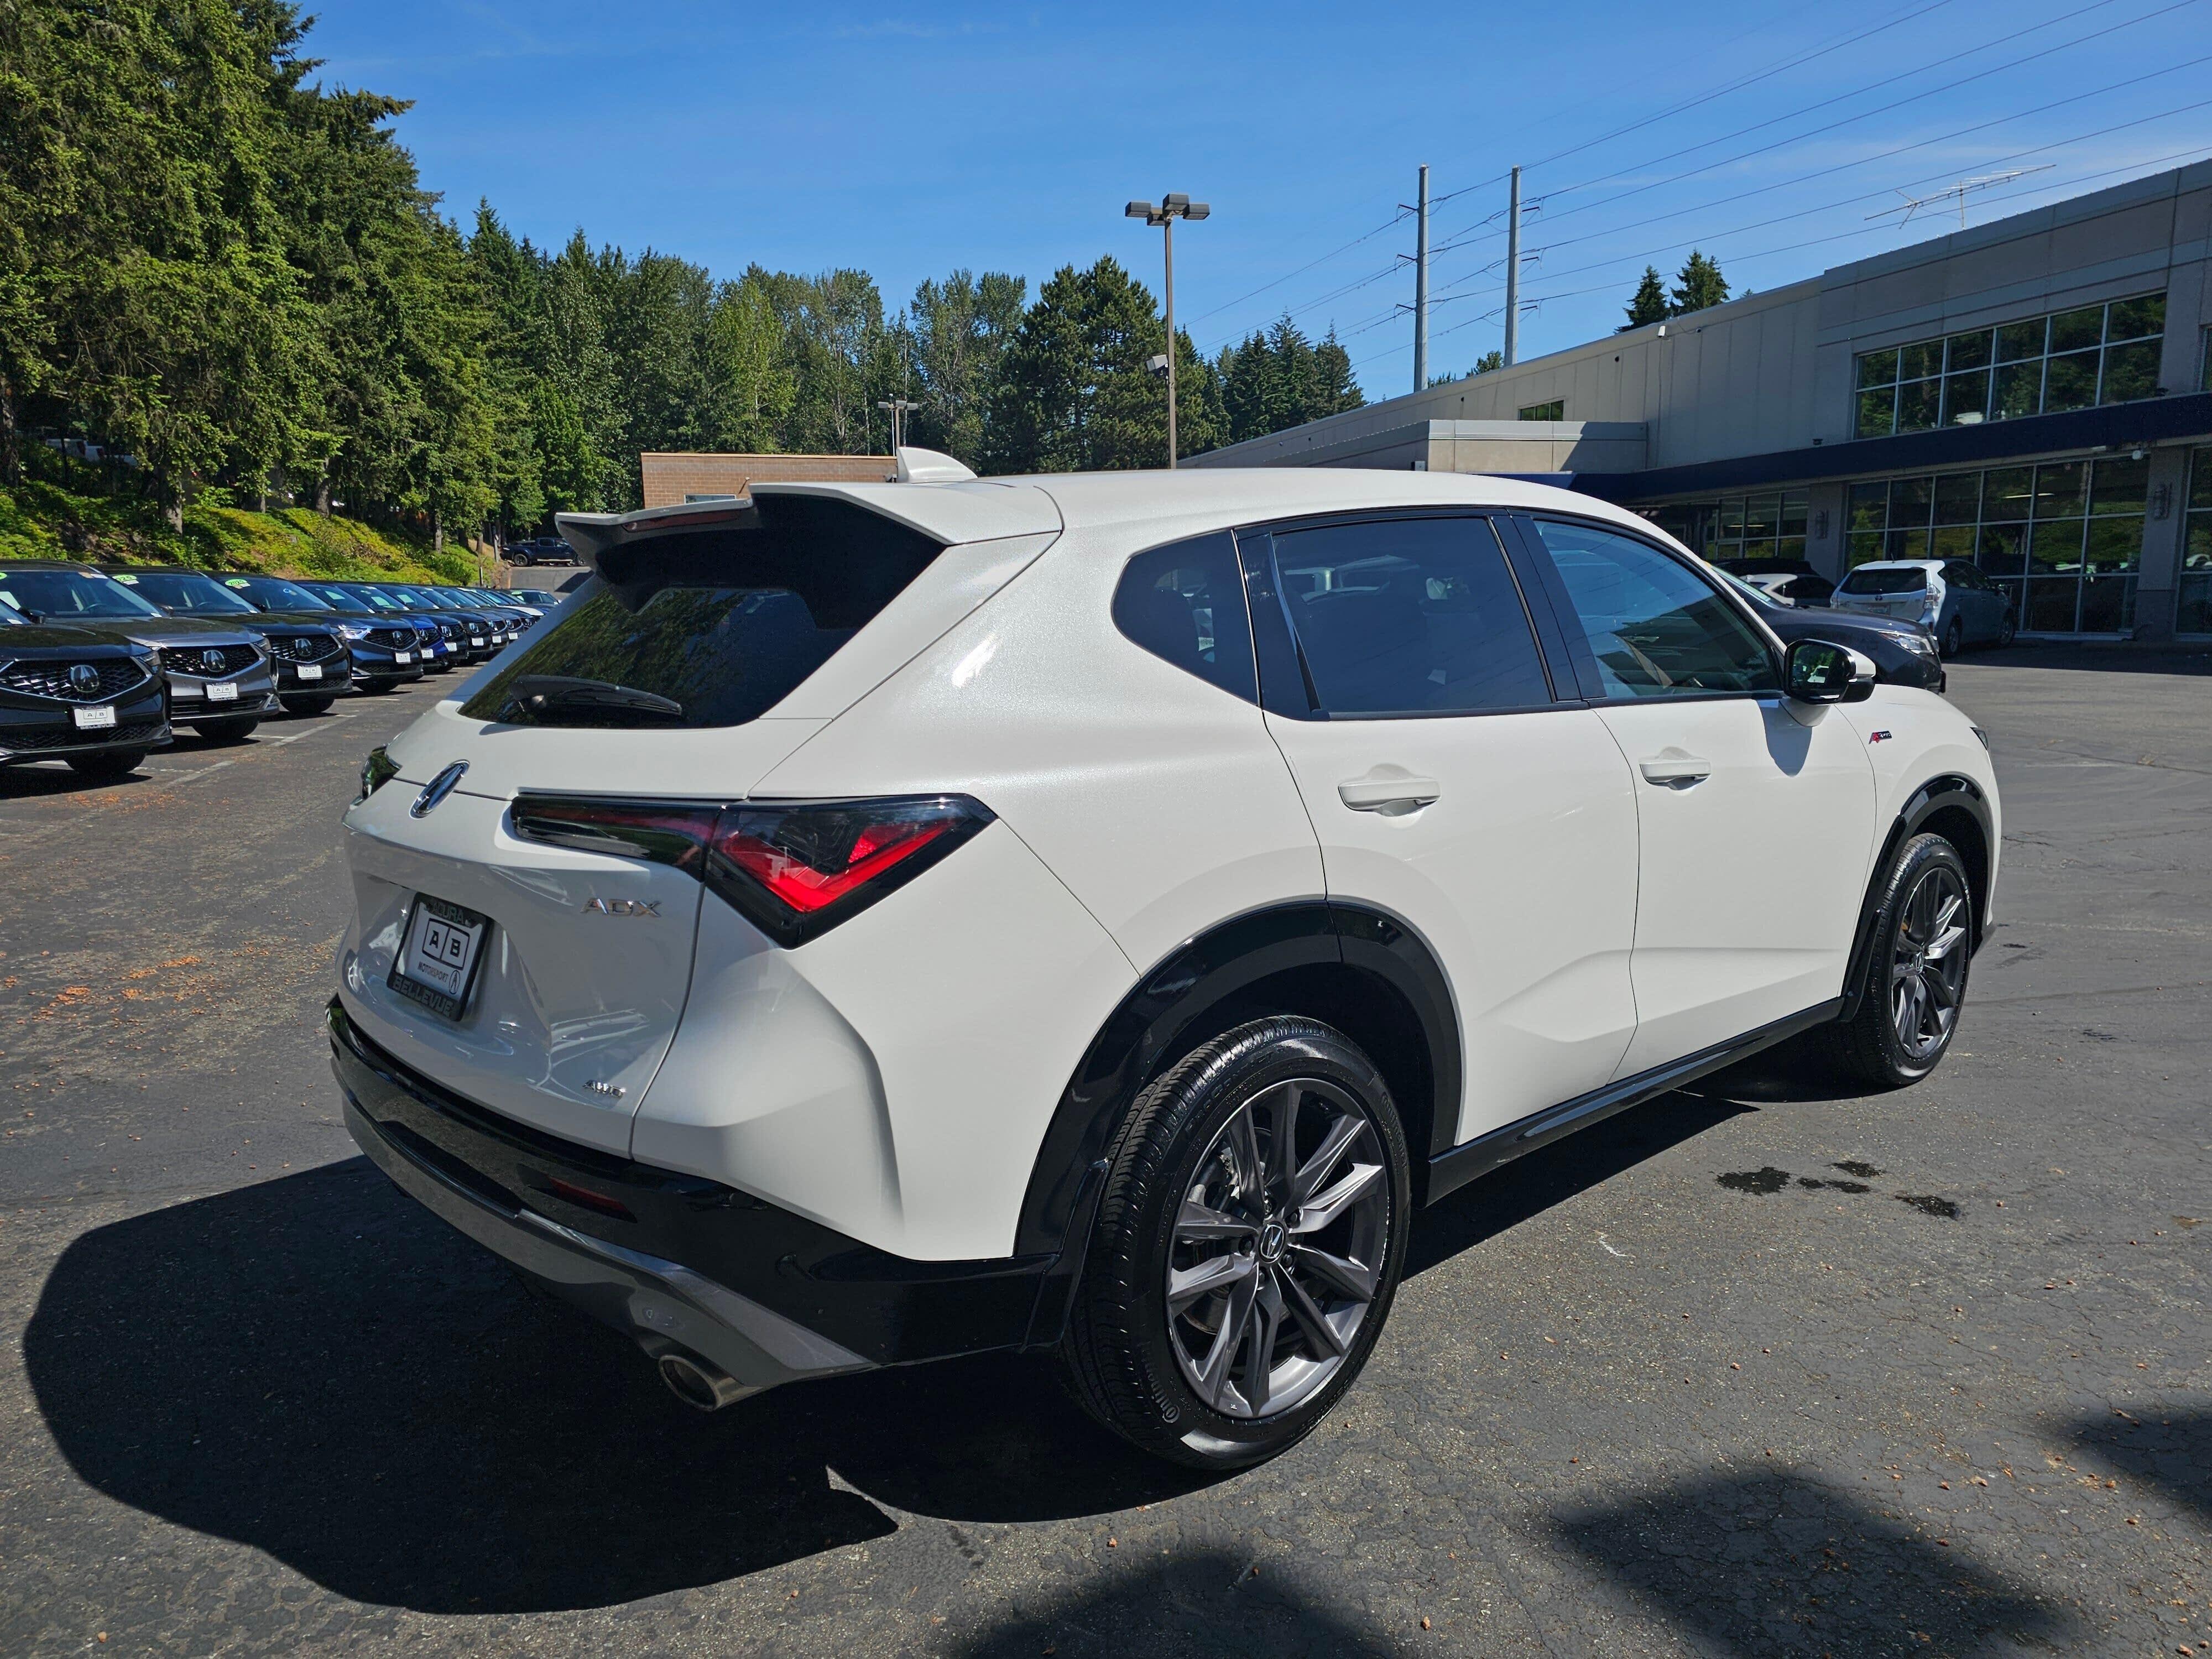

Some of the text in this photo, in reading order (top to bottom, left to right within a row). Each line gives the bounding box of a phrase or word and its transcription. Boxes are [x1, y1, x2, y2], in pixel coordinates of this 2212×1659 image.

[434, 901, 465, 922] ACURA
[580, 898, 662, 917] ADX
[393, 976, 455, 1018] BELLEVUE
